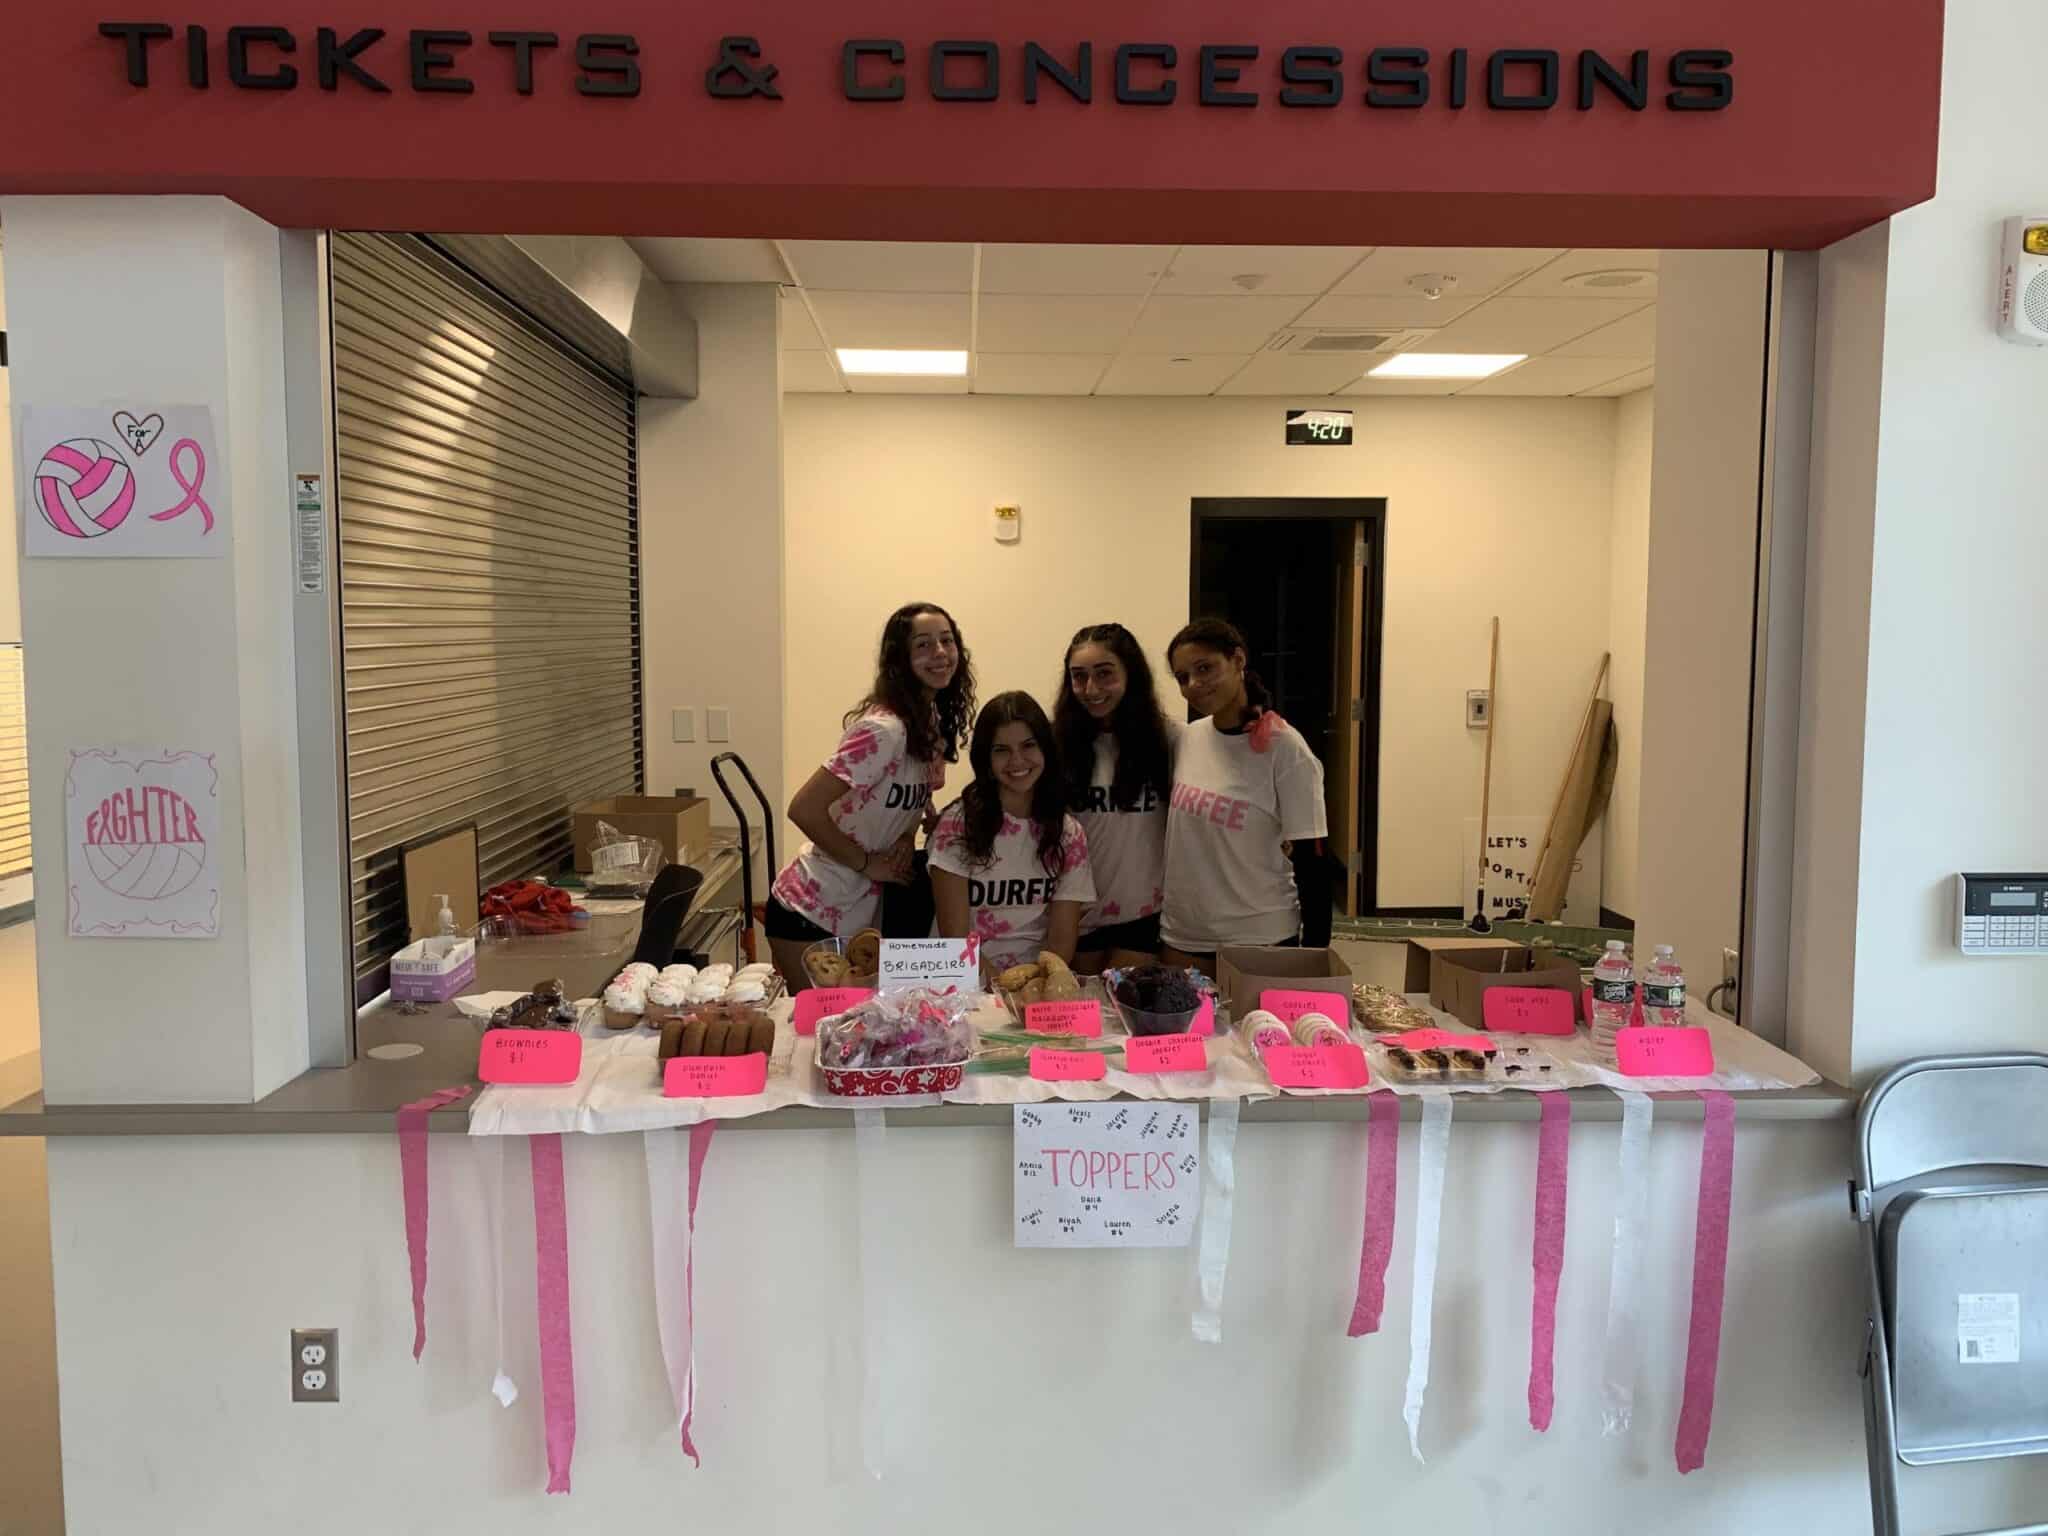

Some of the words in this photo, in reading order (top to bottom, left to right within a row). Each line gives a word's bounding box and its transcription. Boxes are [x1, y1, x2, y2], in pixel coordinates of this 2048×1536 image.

[97, 22, 643, 98] TICKETS
[704, 34, 784, 102] &
[842, 38, 1735, 113] CONCESSIONS
[1487, 836, 1528, 849] LET'S
[883, 960, 966, 973] BRIGADEIRO
[1040, 1149, 1176, 1190] TOPPERS
[1104, 1219, 1132, 1228] Lauren
